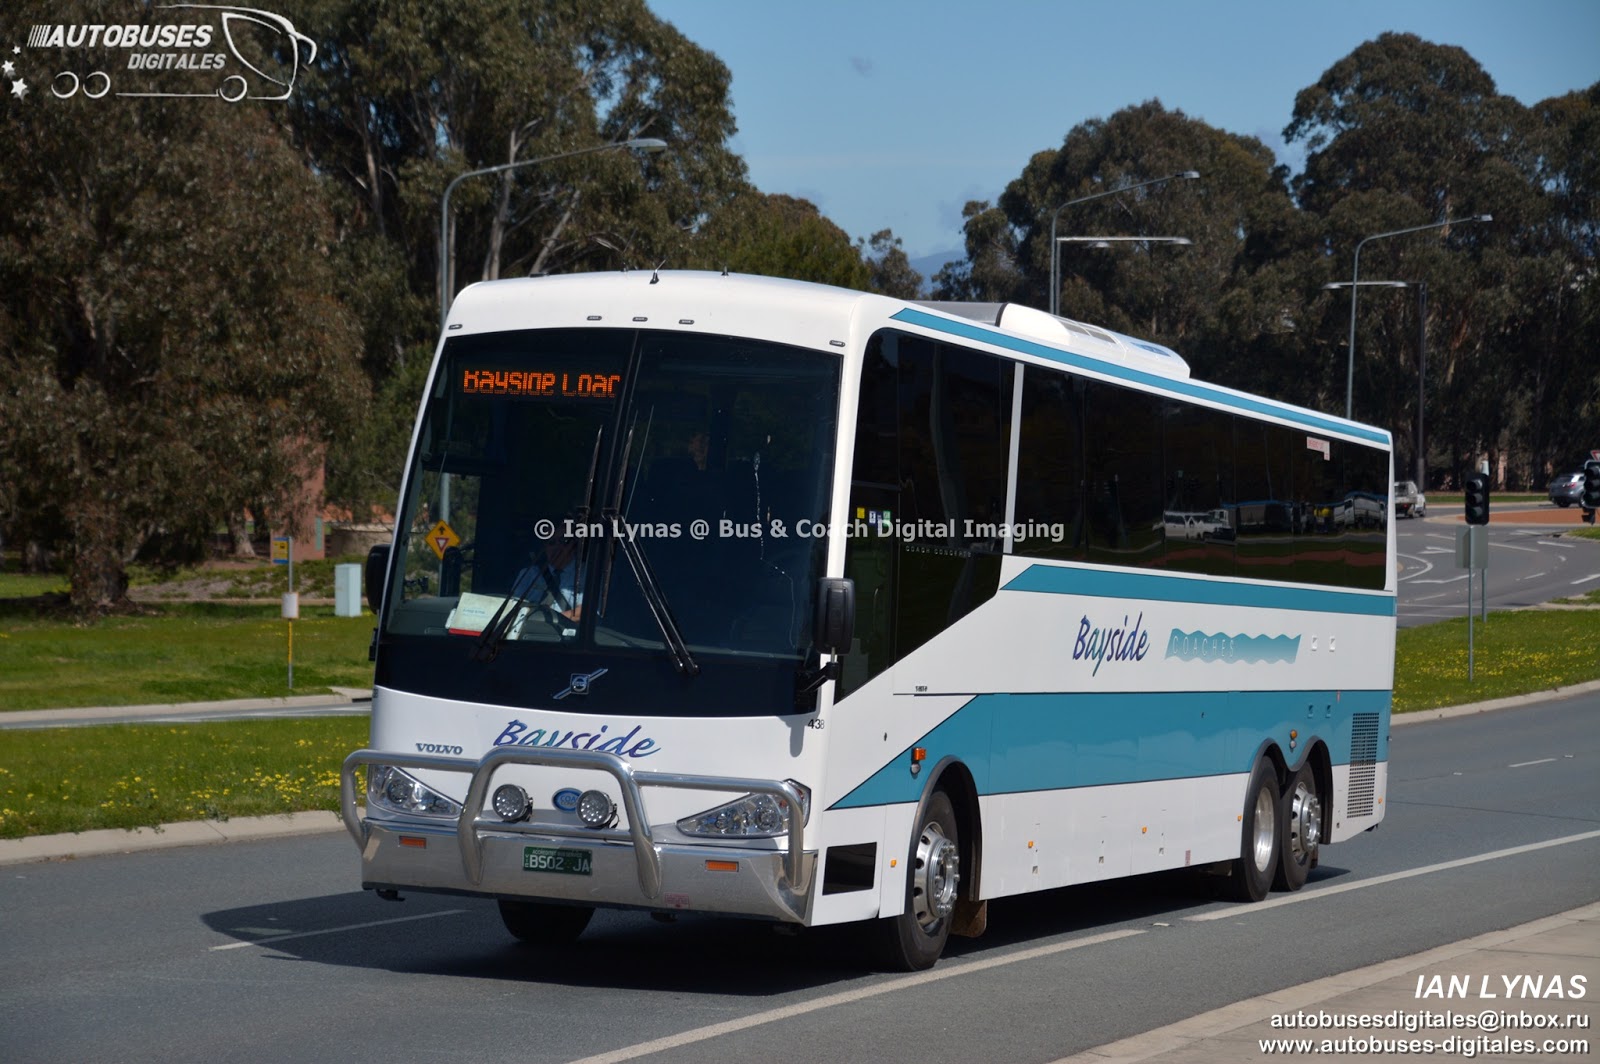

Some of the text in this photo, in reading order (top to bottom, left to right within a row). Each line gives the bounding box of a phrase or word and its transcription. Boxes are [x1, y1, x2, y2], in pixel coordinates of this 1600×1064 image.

[1072, 611, 1151, 678] Bayside
[1173, 635, 1235, 657] COACHES
[807, 718, 825, 730] 438
[415, 742, 464, 756] VOLVO
[529, 854, 590, 873] BS02 JA
